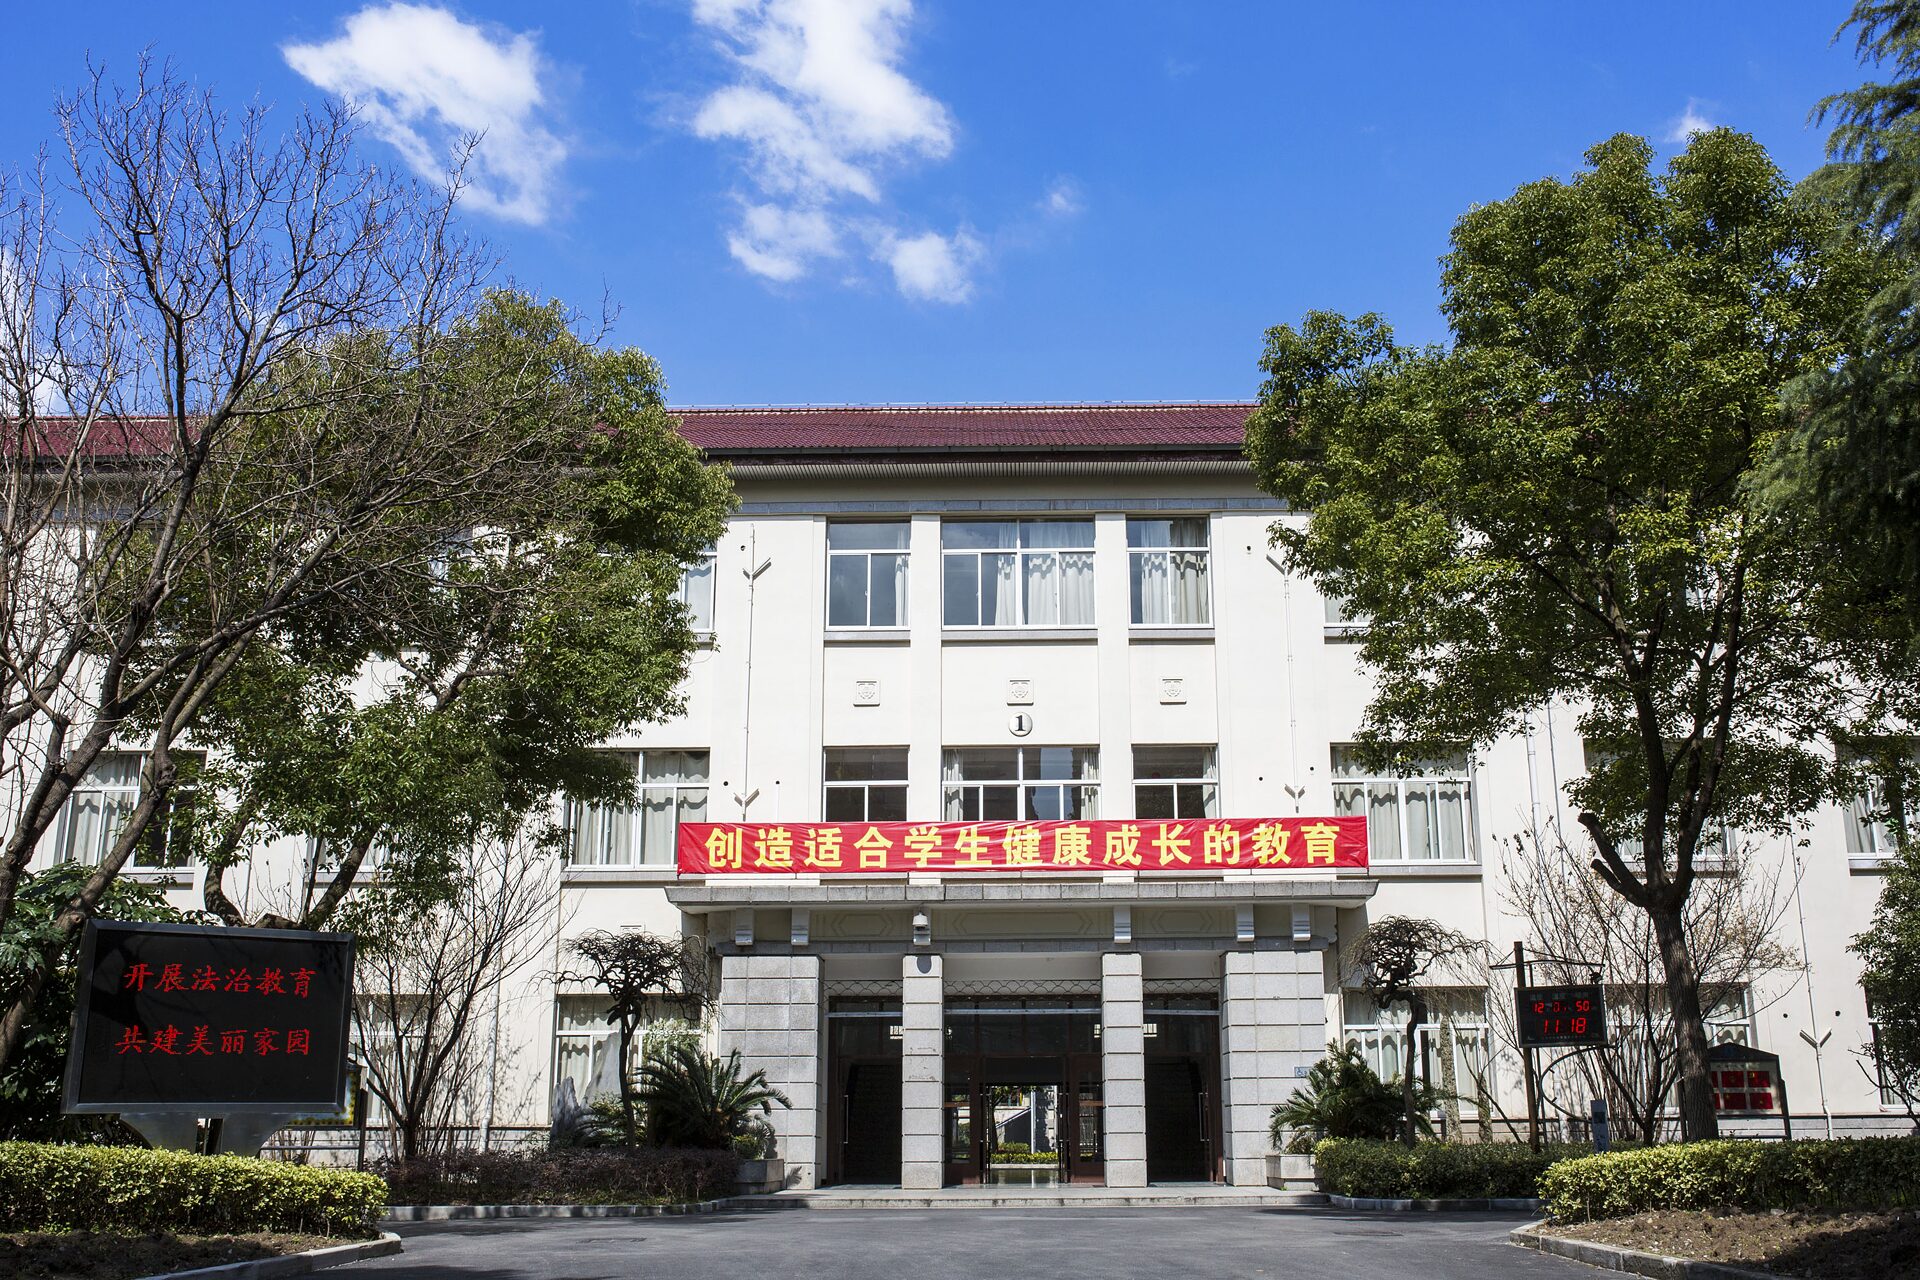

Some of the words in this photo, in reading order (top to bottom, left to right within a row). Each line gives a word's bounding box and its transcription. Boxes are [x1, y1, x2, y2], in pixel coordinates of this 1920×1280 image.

[1014, 714, 1027, 732] 1
[704, 822, 1340, 869] 创造适合学生健康成长的教育
[124, 962, 316, 998] 开展法治教育
[1575, 1000, 1590, 1012] 50
[115, 1024, 310, 1056] 共建美丽家园
